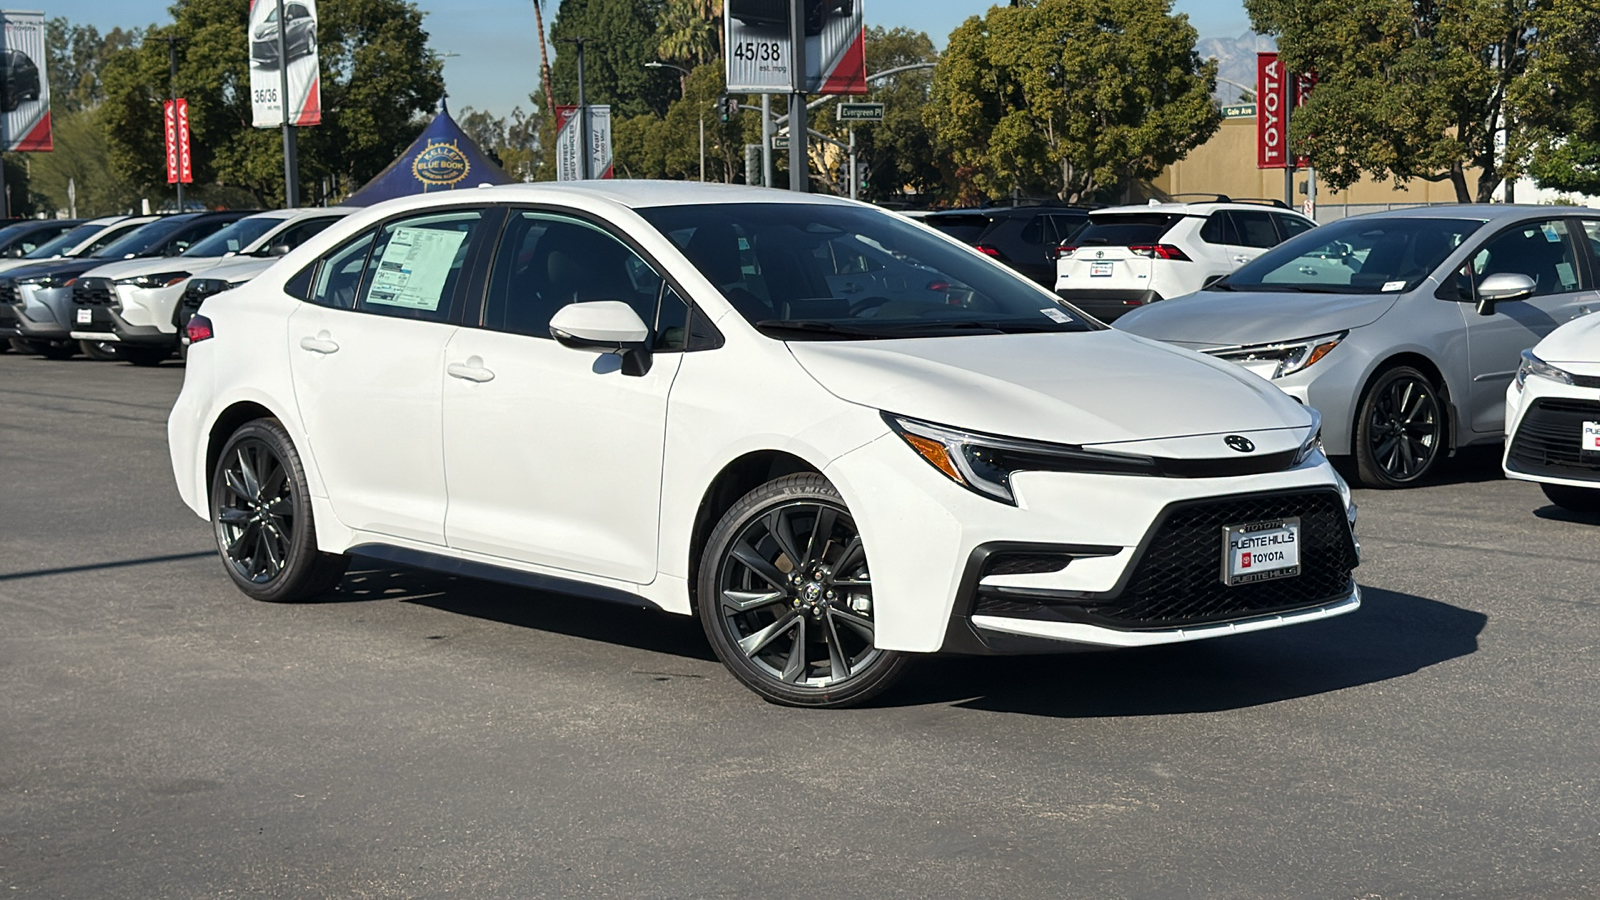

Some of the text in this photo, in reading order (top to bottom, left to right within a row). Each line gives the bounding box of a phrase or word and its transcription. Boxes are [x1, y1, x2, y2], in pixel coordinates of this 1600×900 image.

[734, 42, 781, 61] 45/38
[254, 88, 277, 103] 36/36
[842, 106, 883, 118] Evergreen Pl
[1227, 107, 1252, 116] Gale Ave
[1265, 60, 1279, 162] TOYOTA
[167, 105, 177, 178] TOYOTA
[179, 104, 190, 178] TOYOTA
[424, 147, 461, 160] KELLEY
[417, 160, 464, 170] BLUE BOOK
[1246, 520, 1283, 532] TOYOTA
[1230, 532, 1295, 550] PUENTE HILLS
[1252, 551, 1284, 564] TOYOTA
[1231, 566, 1297, 584] PUENTE HILLS
